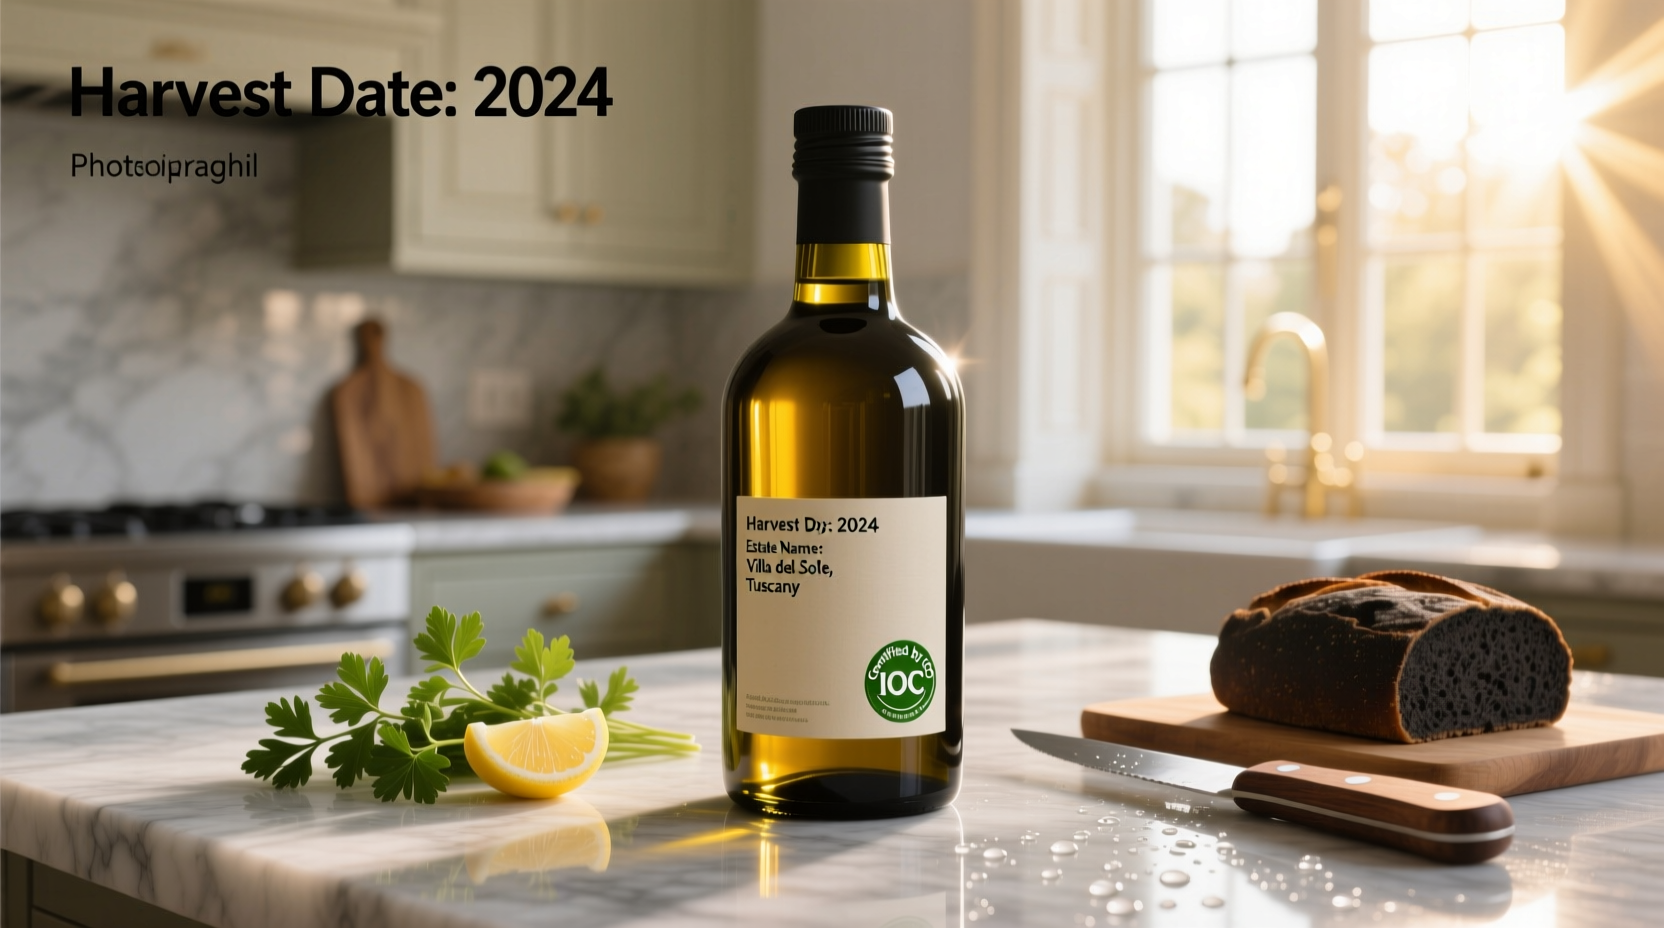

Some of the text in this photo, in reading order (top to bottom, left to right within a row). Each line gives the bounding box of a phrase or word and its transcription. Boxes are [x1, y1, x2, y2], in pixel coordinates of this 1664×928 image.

[746, 516, 800, 532] Harvest
[837, 516, 880, 533] 2024
[746, 539, 823, 555] Estate Name:
[746, 558, 834, 577] Villa del Sole,
[746, 577, 800, 597] Tuscany
[880, 670, 925, 696] IOC
